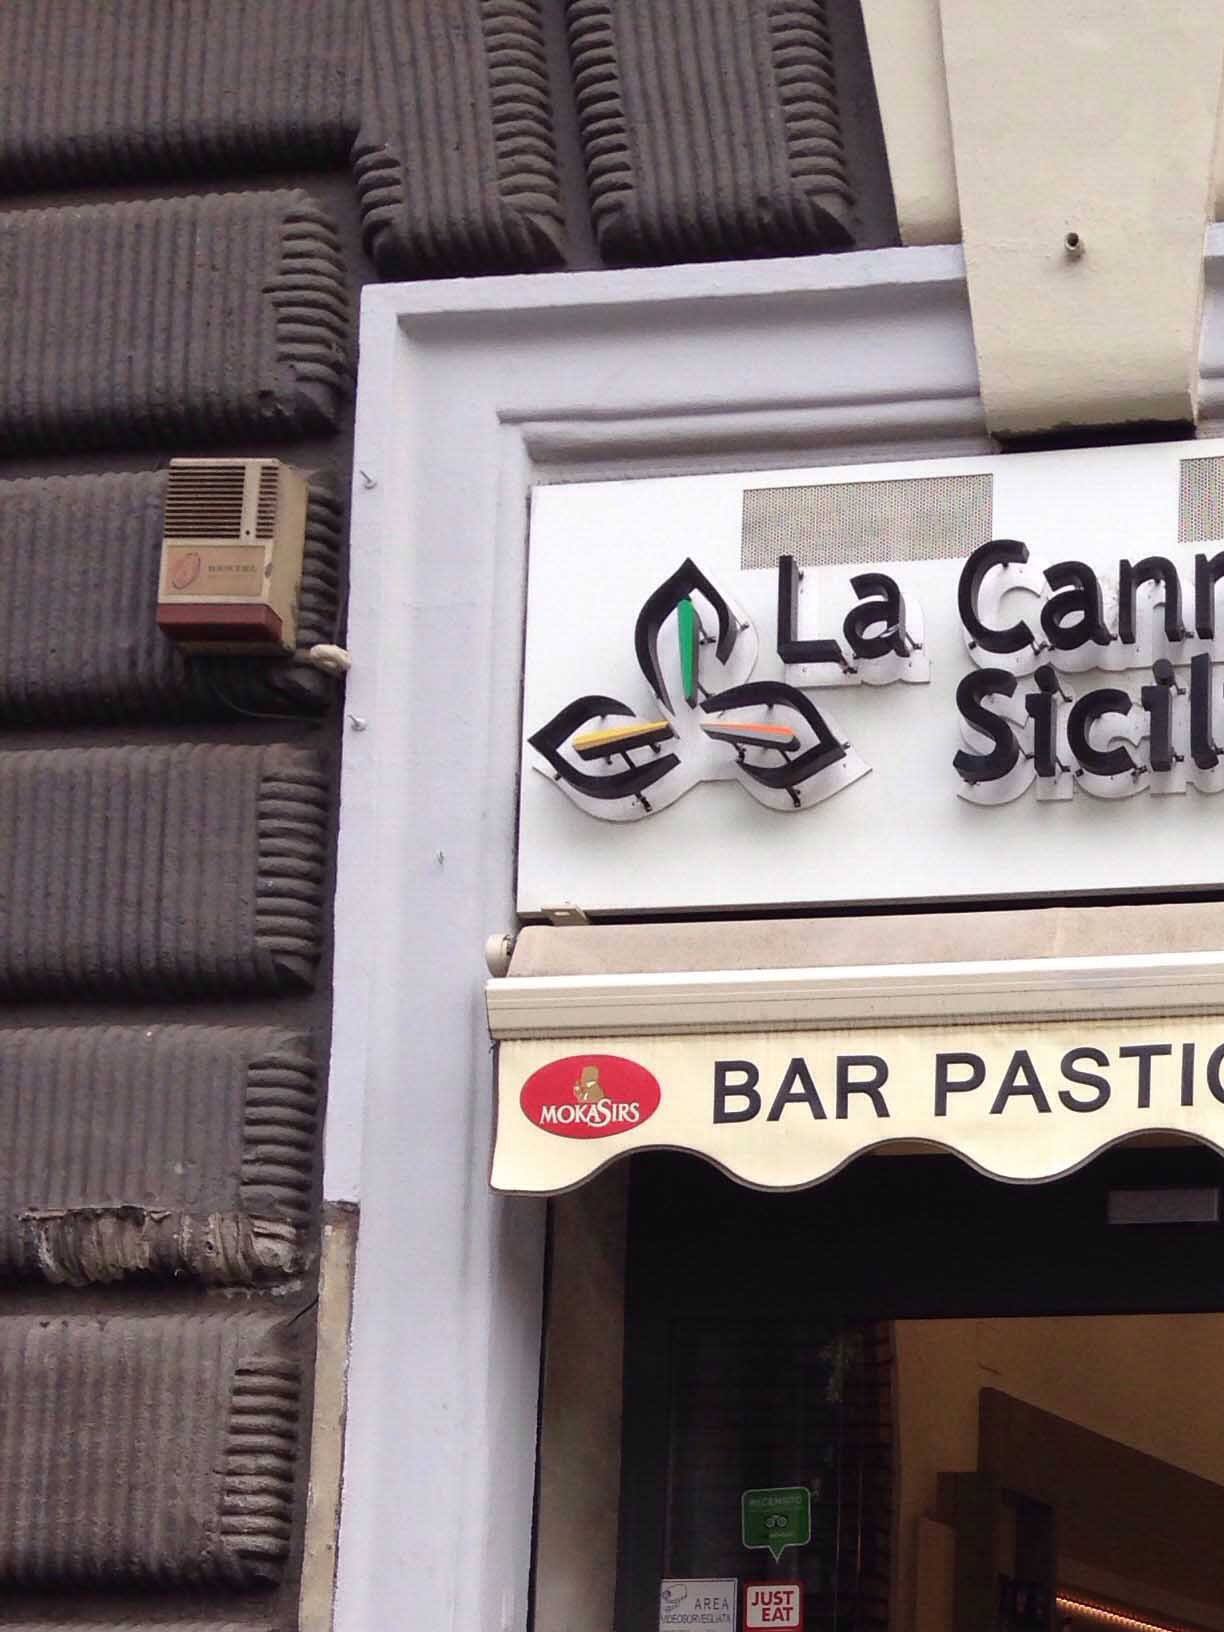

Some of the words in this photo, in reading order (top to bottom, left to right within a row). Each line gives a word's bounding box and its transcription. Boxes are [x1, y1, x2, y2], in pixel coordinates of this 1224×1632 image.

[775, 554, 910, 668] La
[711, 1053, 891, 1126] BAR
[539, 1097, 641, 1128] MOKASIRS
[693, 1596, 730, 1611] AREA
[751, 1589, 795, 1607] JUST
[761, 1606, 795, 1623] EAT
